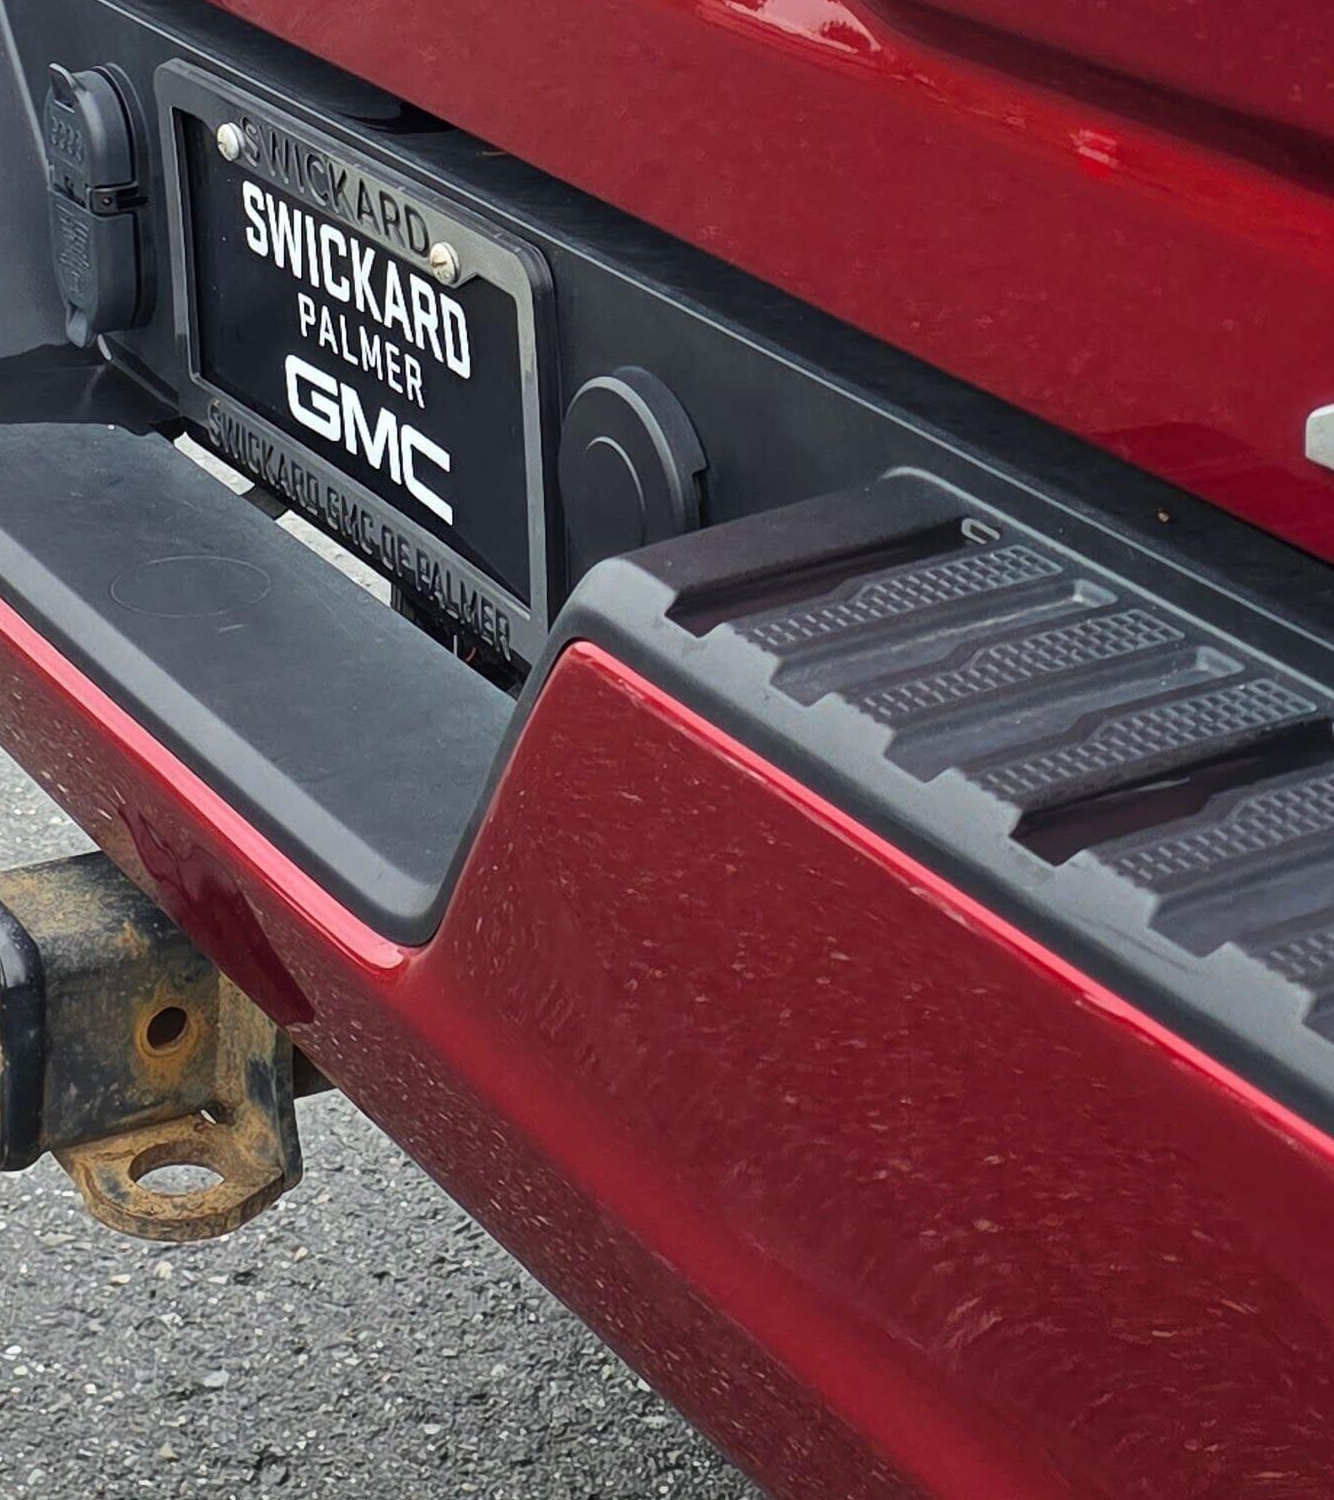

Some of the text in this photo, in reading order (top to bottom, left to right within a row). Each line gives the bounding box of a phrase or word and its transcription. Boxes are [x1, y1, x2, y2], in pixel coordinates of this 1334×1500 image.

[240, 116, 431, 259] SWICKARD
[242, 180, 471, 380] SWICKARD
[297, 292, 426, 409] PALMER
[284, 354, 454, 526] GMC
[207, 398, 512, 662] SWICKARD GMC OF PALMER
